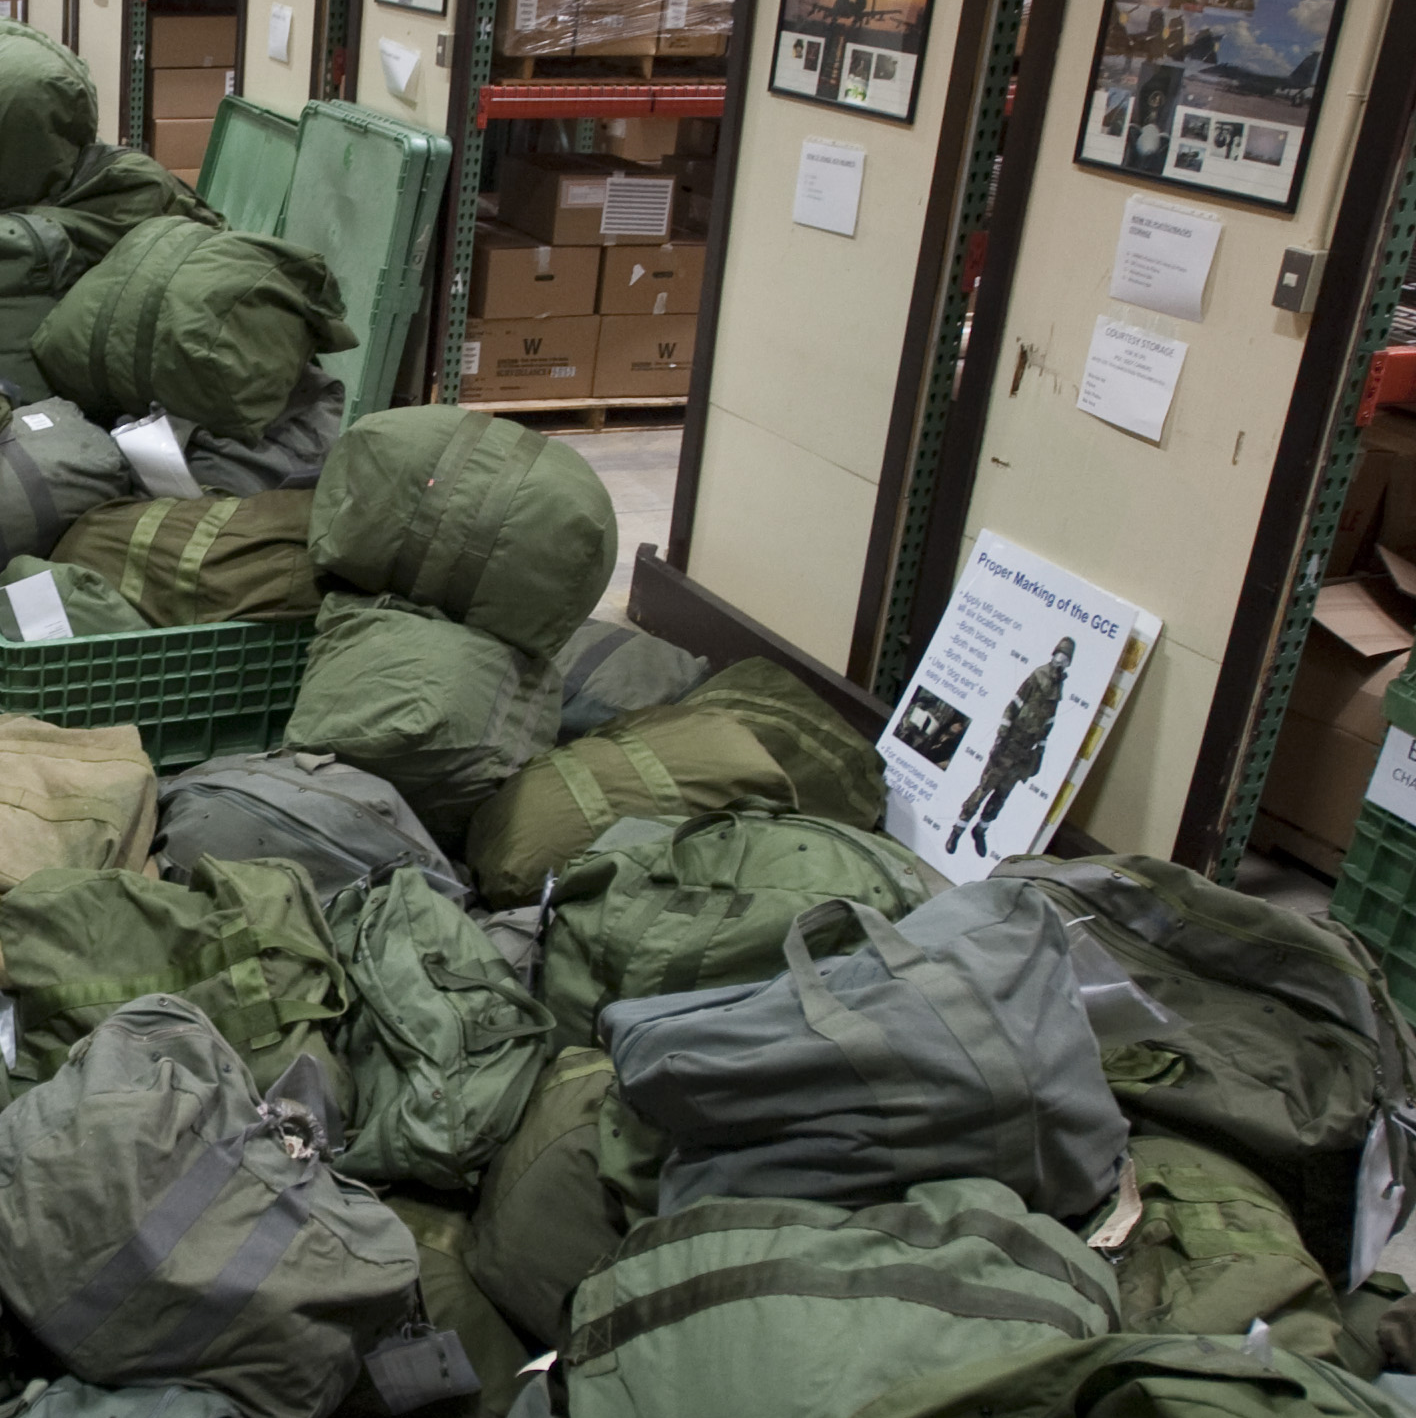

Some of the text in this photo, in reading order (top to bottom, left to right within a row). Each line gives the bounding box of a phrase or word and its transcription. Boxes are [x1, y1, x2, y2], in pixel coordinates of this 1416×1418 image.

[523, 338, 543, 355] W
[658, 343, 677, 359] W
[1105, 327, 1141, 348] COURTESY
[1141, 337, 1175, 358] STORAGE
[977, 552, 1119, 639] Proper Marking of the GCE
[963, 592, 981, 608] Apply
[992, 610, 1013, 625] paper
[1012, 621, 1022, 631] on
[976, 613, 1005, 635] locations
[974, 631, 996, 649] biceps
[926, 670, 967, 699] easy removal
[931, 657, 945, 670] Use
[978, 686, 988, 697] for
[885, 746, 896, 759] For
[924, 779, 938, 790] use
[918, 786, 933, 801] and
